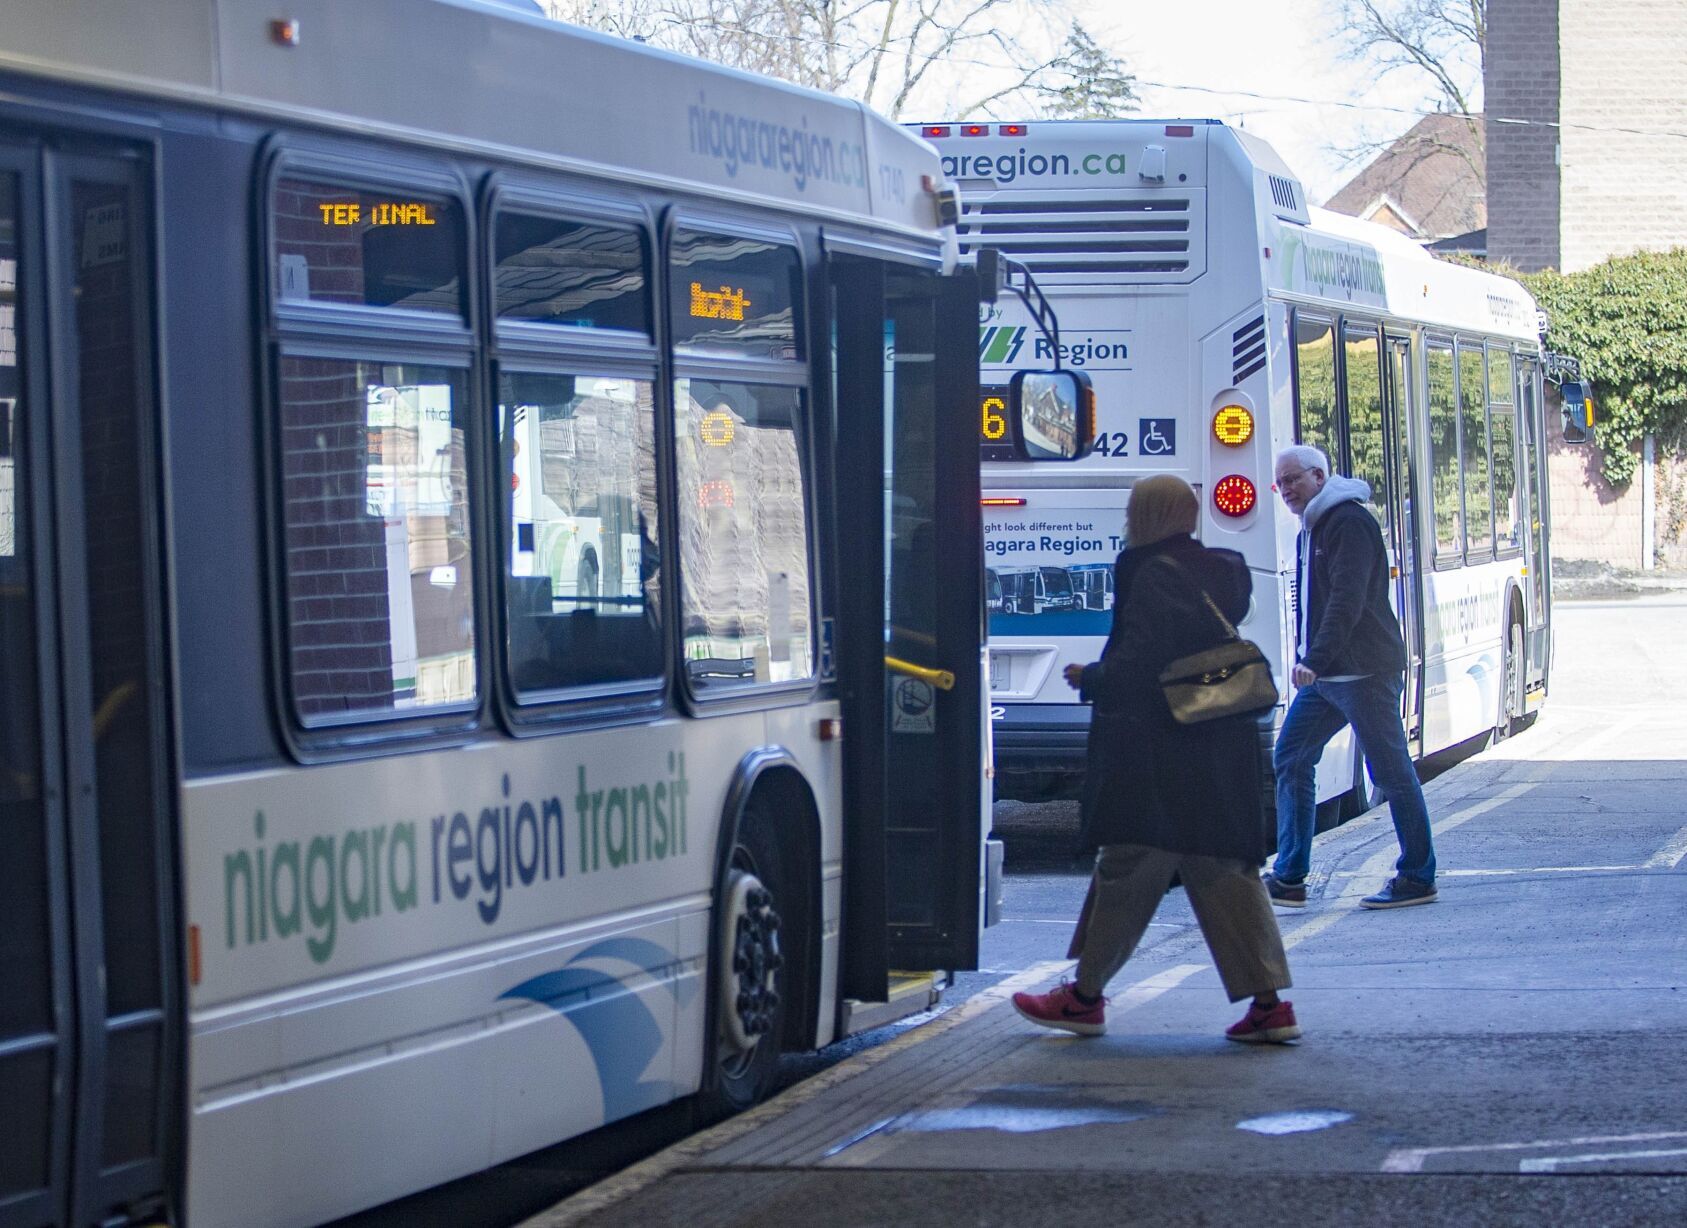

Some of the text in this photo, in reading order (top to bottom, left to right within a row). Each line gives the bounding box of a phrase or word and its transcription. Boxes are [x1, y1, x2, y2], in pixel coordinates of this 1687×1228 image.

[688, 91, 866, 192] niagararegion.ca
[941, 147, 1126, 183] aregion.ca
[1034, 338, 1128, 366] Region
[1004, 522, 1026, 531] look
[1029, 522, 1073, 531] different
[1076, 522, 1093, 531] but
[1040, 536, 1103, 555] Region
[223, 750, 690, 964] niagara region transit
